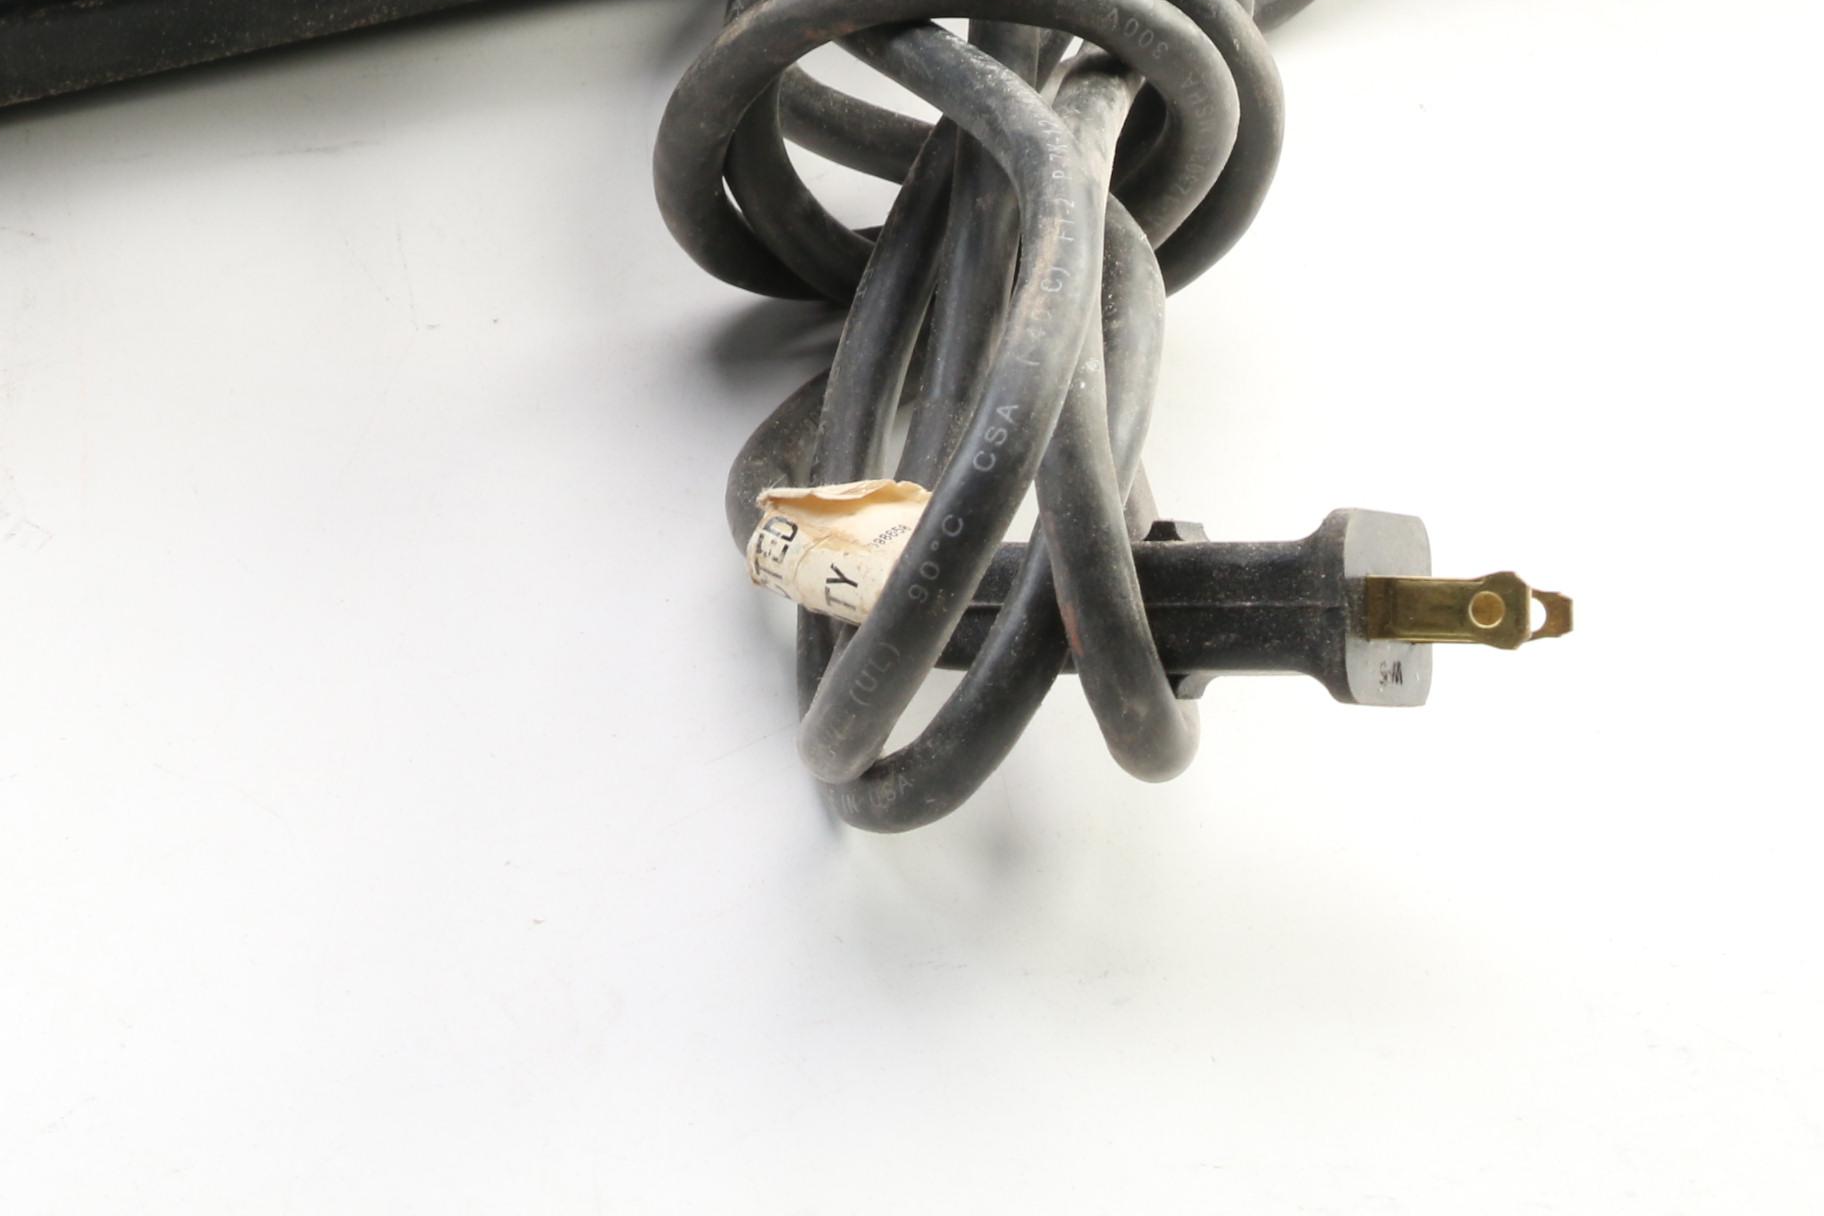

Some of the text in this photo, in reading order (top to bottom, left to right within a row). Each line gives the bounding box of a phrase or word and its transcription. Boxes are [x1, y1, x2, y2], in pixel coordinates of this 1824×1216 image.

[1105, 8, 1169, 60] 300V
[850, 642, 901, 706] (UL)
[908, 513, 965, 604] 90°C
[972, 403, 1020, 472] CSA
